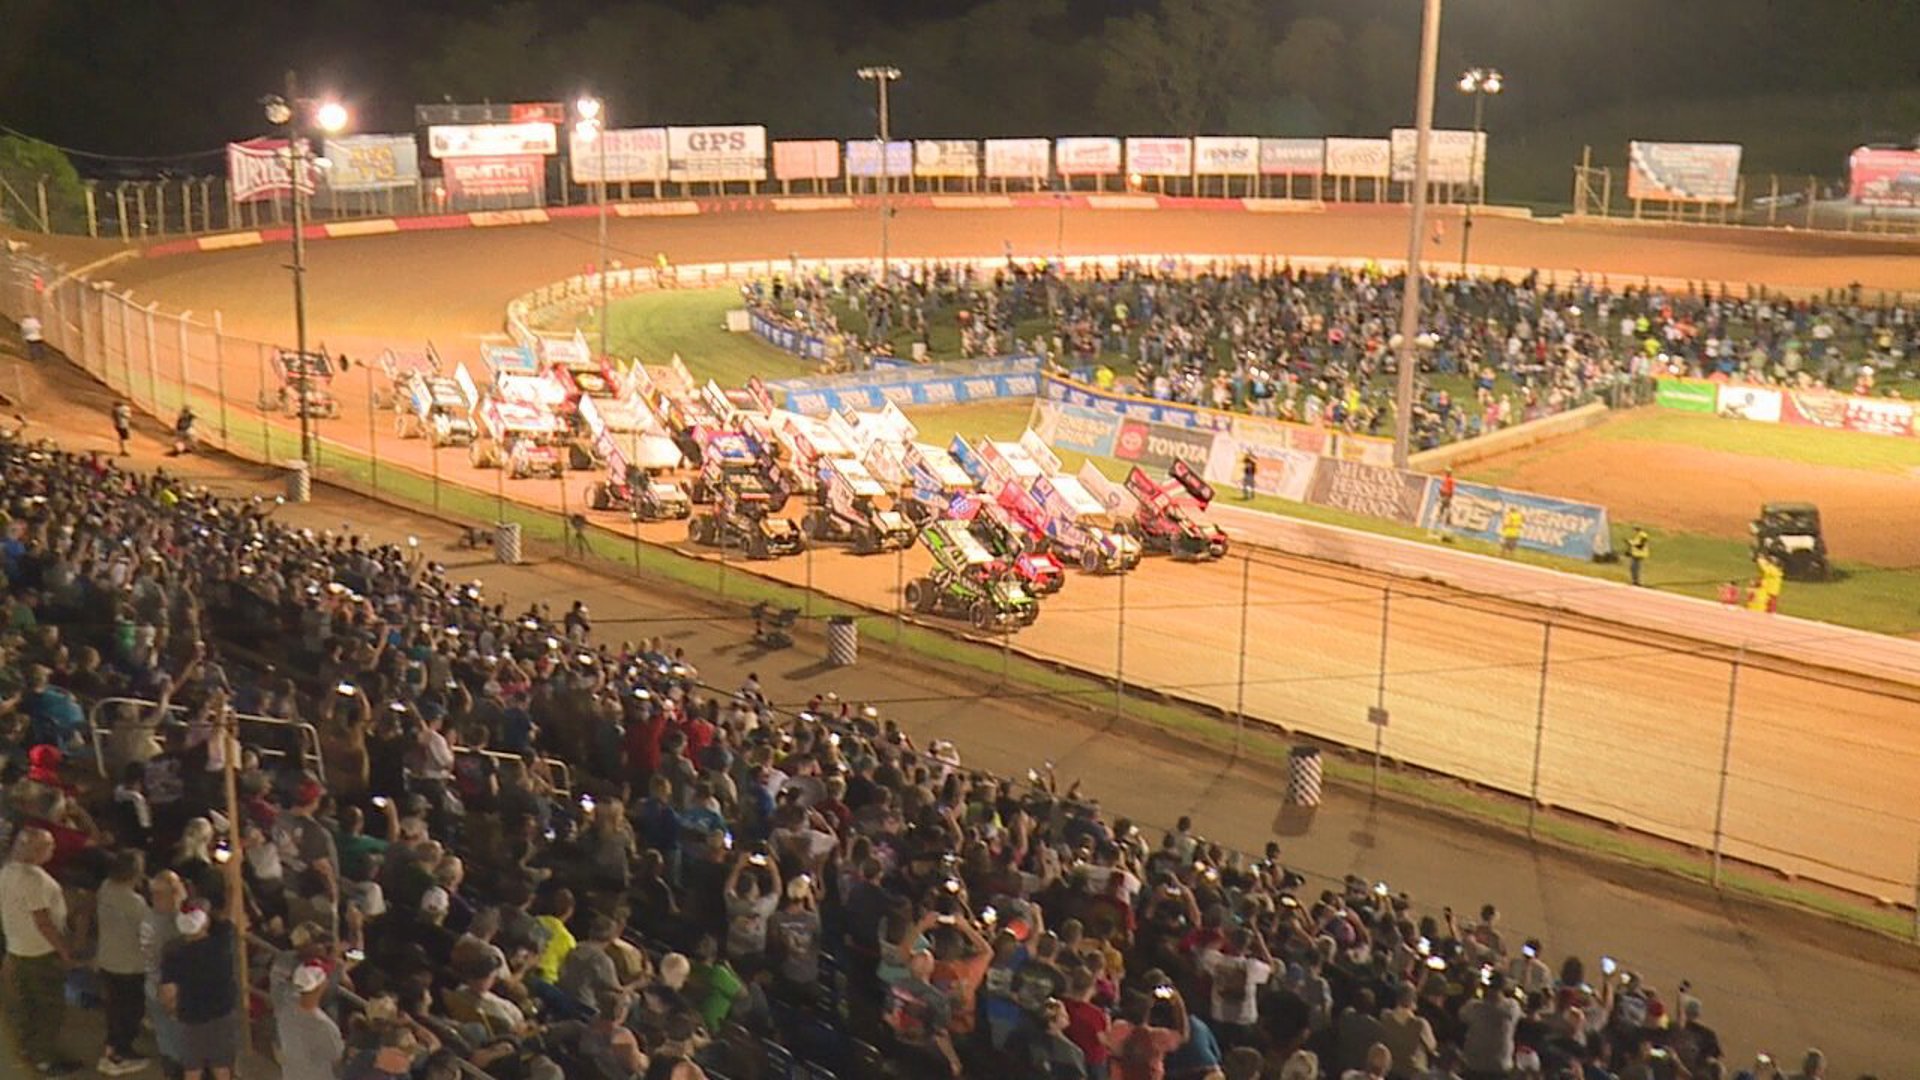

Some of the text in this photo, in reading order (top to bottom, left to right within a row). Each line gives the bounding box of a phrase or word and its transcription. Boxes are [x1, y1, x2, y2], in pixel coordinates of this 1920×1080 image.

[688, 131, 747, 152] GPS
[1147, 435, 1208, 464] TOYOTA
[1337, 460, 1405, 488] MILTON
[1331, 473, 1401, 505] HERSHEY
[1328, 491, 1403, 520] SCHOOL
[1503, 503, 1595, 534] NERGY
